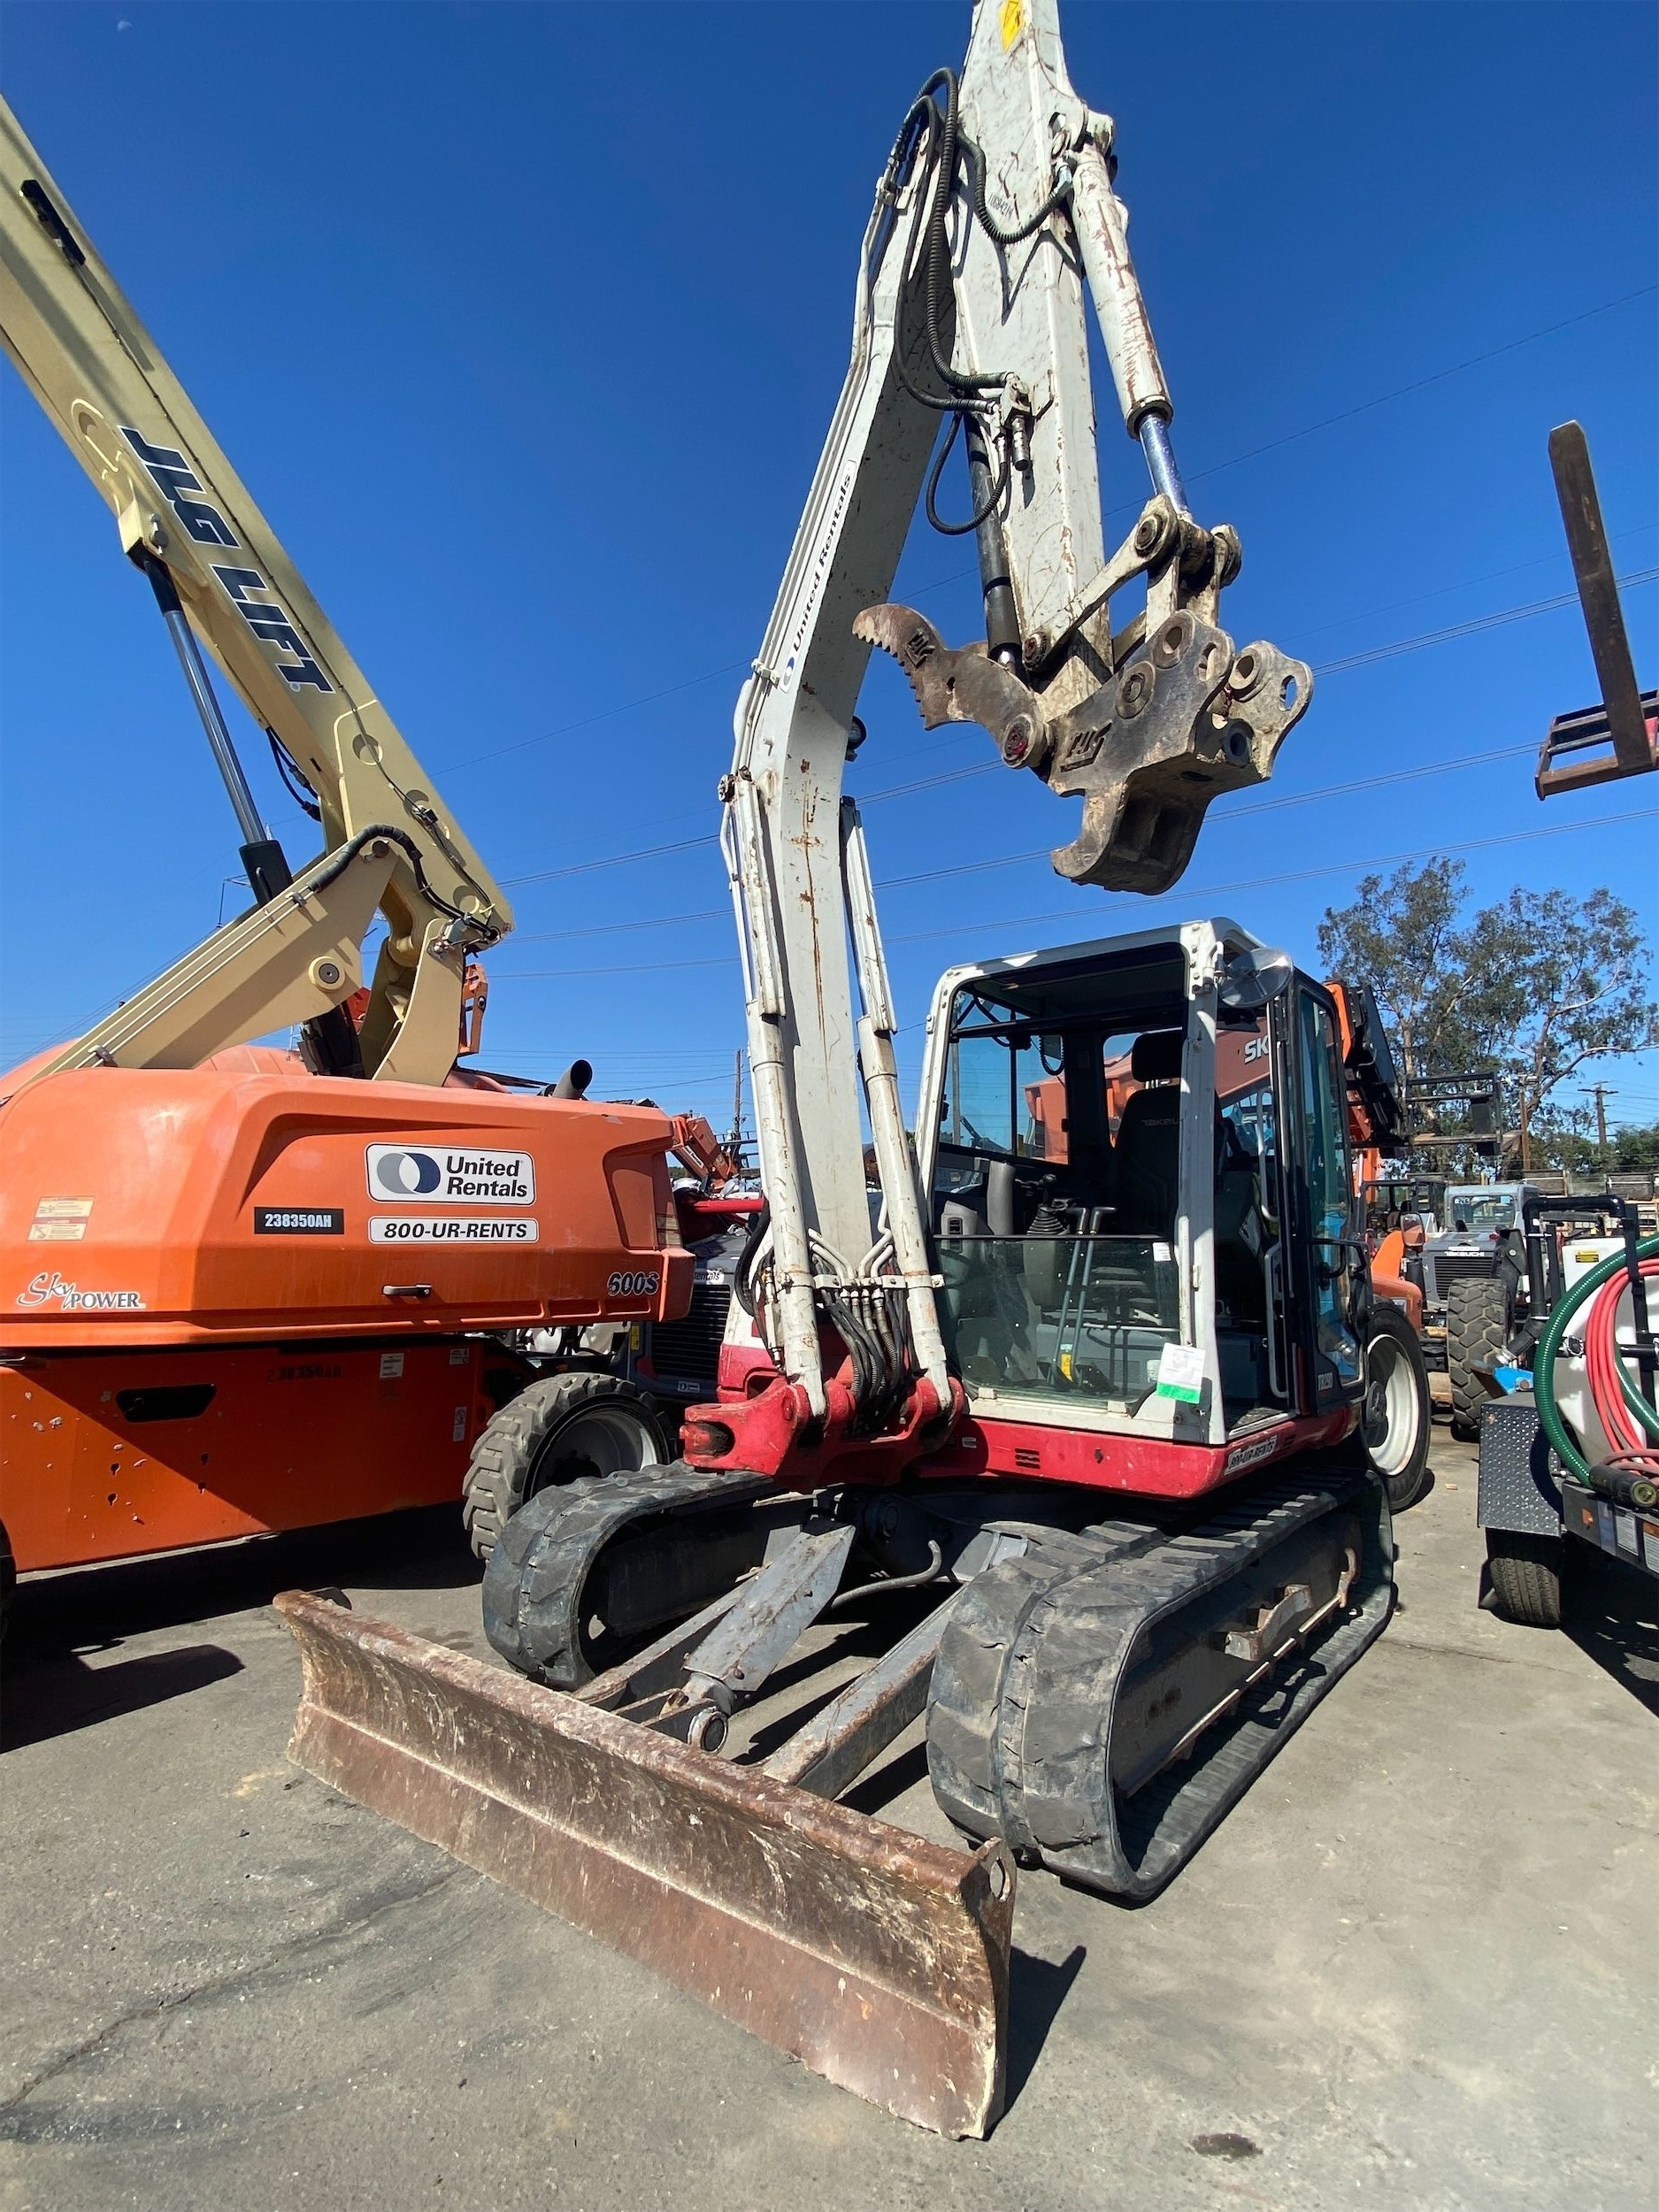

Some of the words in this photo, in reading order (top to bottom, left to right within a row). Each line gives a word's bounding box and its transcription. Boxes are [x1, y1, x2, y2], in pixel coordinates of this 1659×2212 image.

[117, 425, 242, 549] JLG
[209, 563, 337, 694] LIFT
[793, 570, 821, 653] United
[817, 473, 851, 567] Rentals
[446, 1155, 520, 1178] United
[446, 1176, 528, 1198] Rentals
[265, 1213, 333, 1228] 238350AH
[383, 1222, 528, 1239] 800-UR-RENTS
[607, 1271, 661, 1297] 600S
